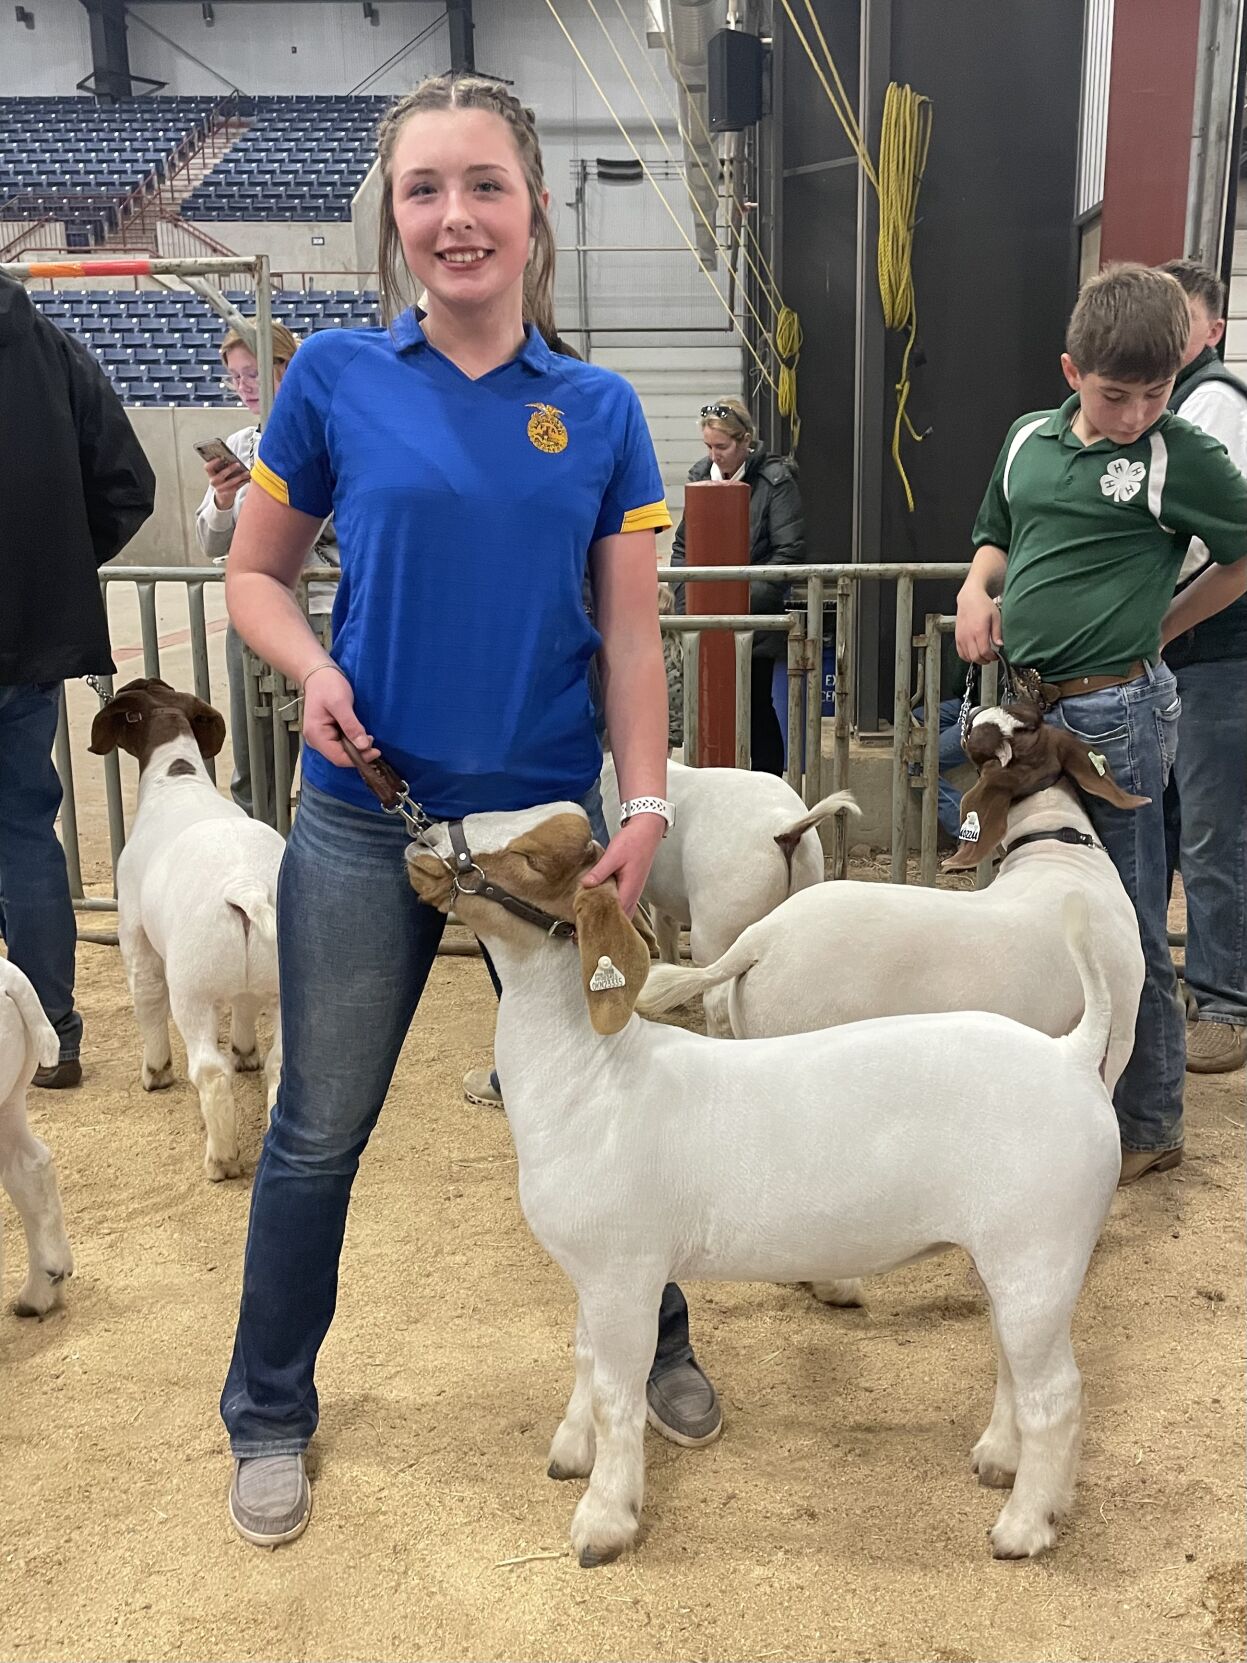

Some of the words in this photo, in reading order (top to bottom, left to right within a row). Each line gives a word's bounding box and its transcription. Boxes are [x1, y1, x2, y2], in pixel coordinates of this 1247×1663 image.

[1114, 463, 1123, 473] H
[1131, 466, 1142, 477] H
[1104, 480, 1116, 489] H
[1125, 484, 1134, 495] H
